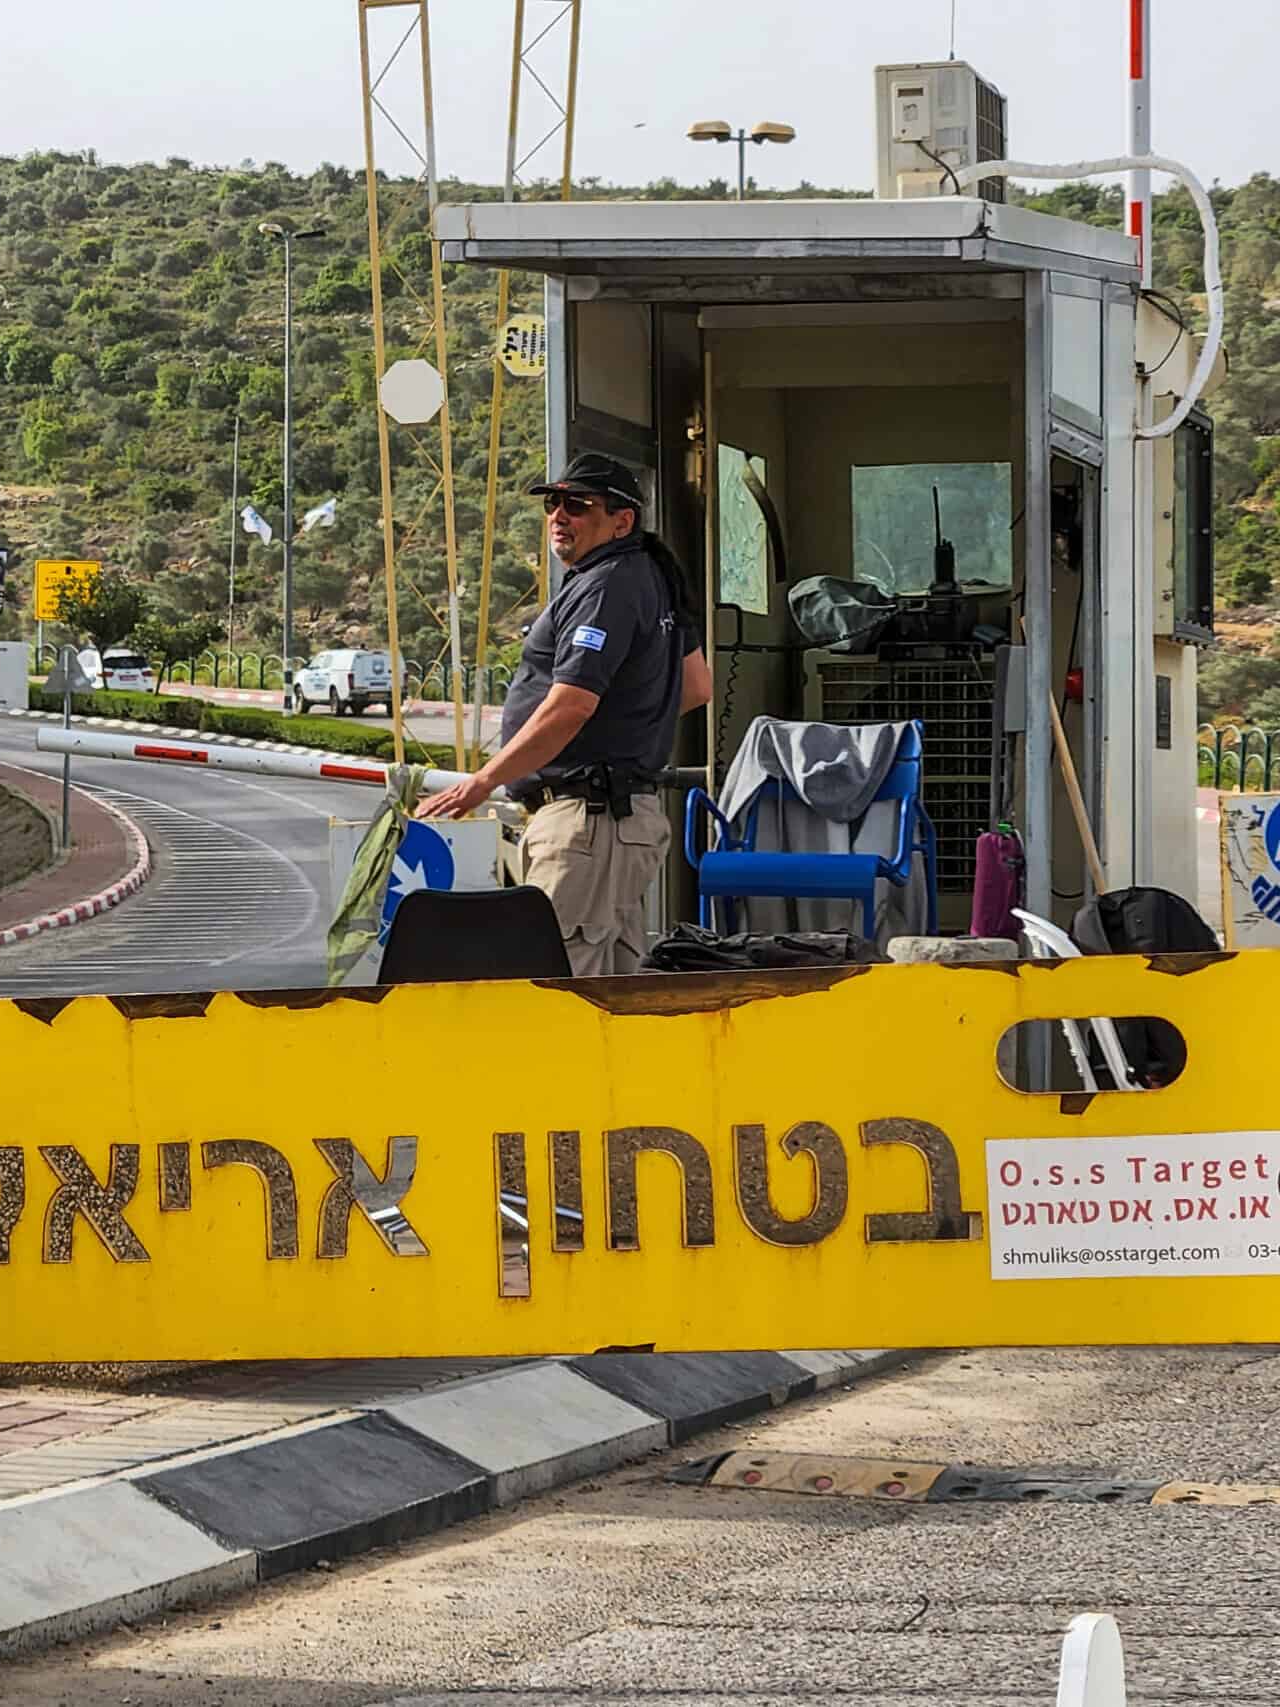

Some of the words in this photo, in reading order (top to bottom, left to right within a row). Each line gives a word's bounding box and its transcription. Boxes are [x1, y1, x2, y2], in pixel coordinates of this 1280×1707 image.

[1000, 1160, 1106, 1187] O.s.s
[1127, 1153, 1270, 1189] Target
[493, 1116, 983, 1298] בטחון
[1001, 1200, 1100, 1226] טארגט
[1109, 1199, 1153, 1223] אס
[1228, 1195, 1271, 1220] או.
[1002, 1244, 1220, 1265] shmuliks@osstarget.com
[1248, 1243, 1280, 1259] 03-
